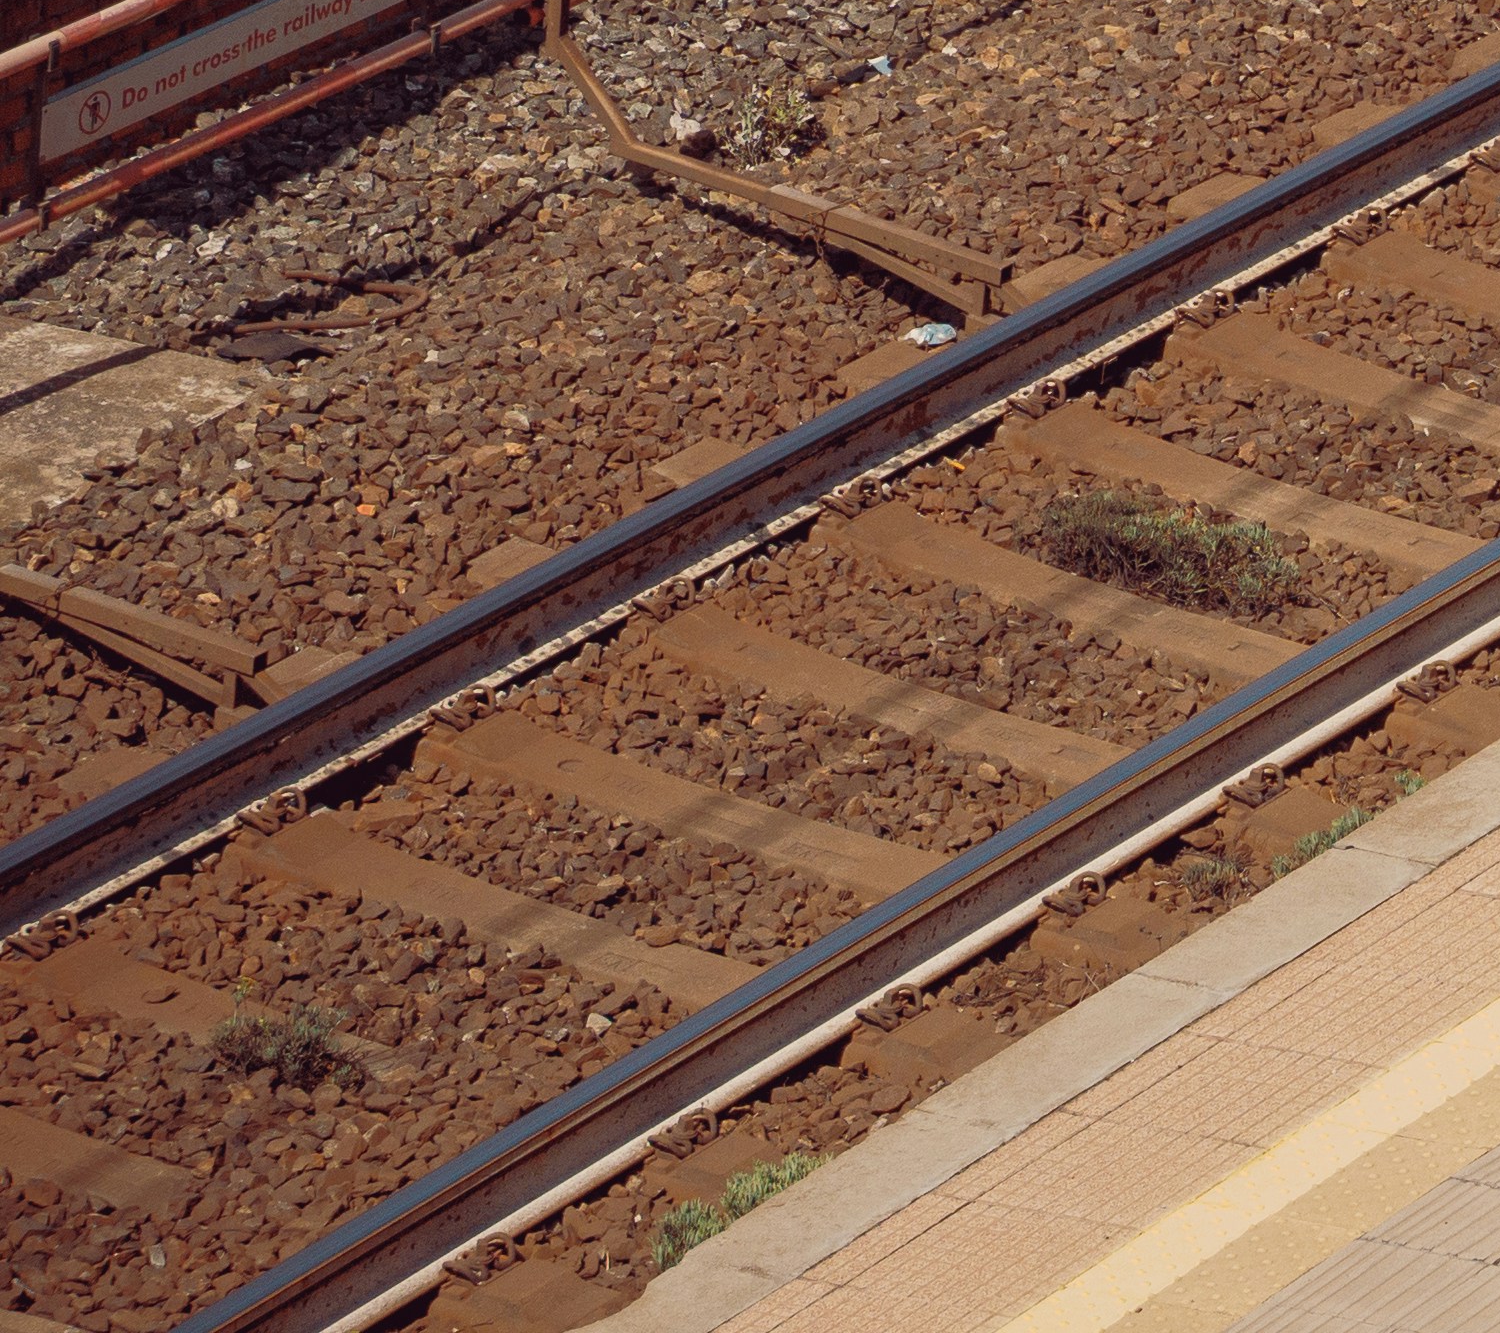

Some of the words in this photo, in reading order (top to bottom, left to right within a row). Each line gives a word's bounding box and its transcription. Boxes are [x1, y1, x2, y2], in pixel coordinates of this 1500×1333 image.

[122, 85, 148, 110] Do
[155, 65, 187, 96] not
[193, 43, 240, 77] cross
[246, 27, 277, 54] the
